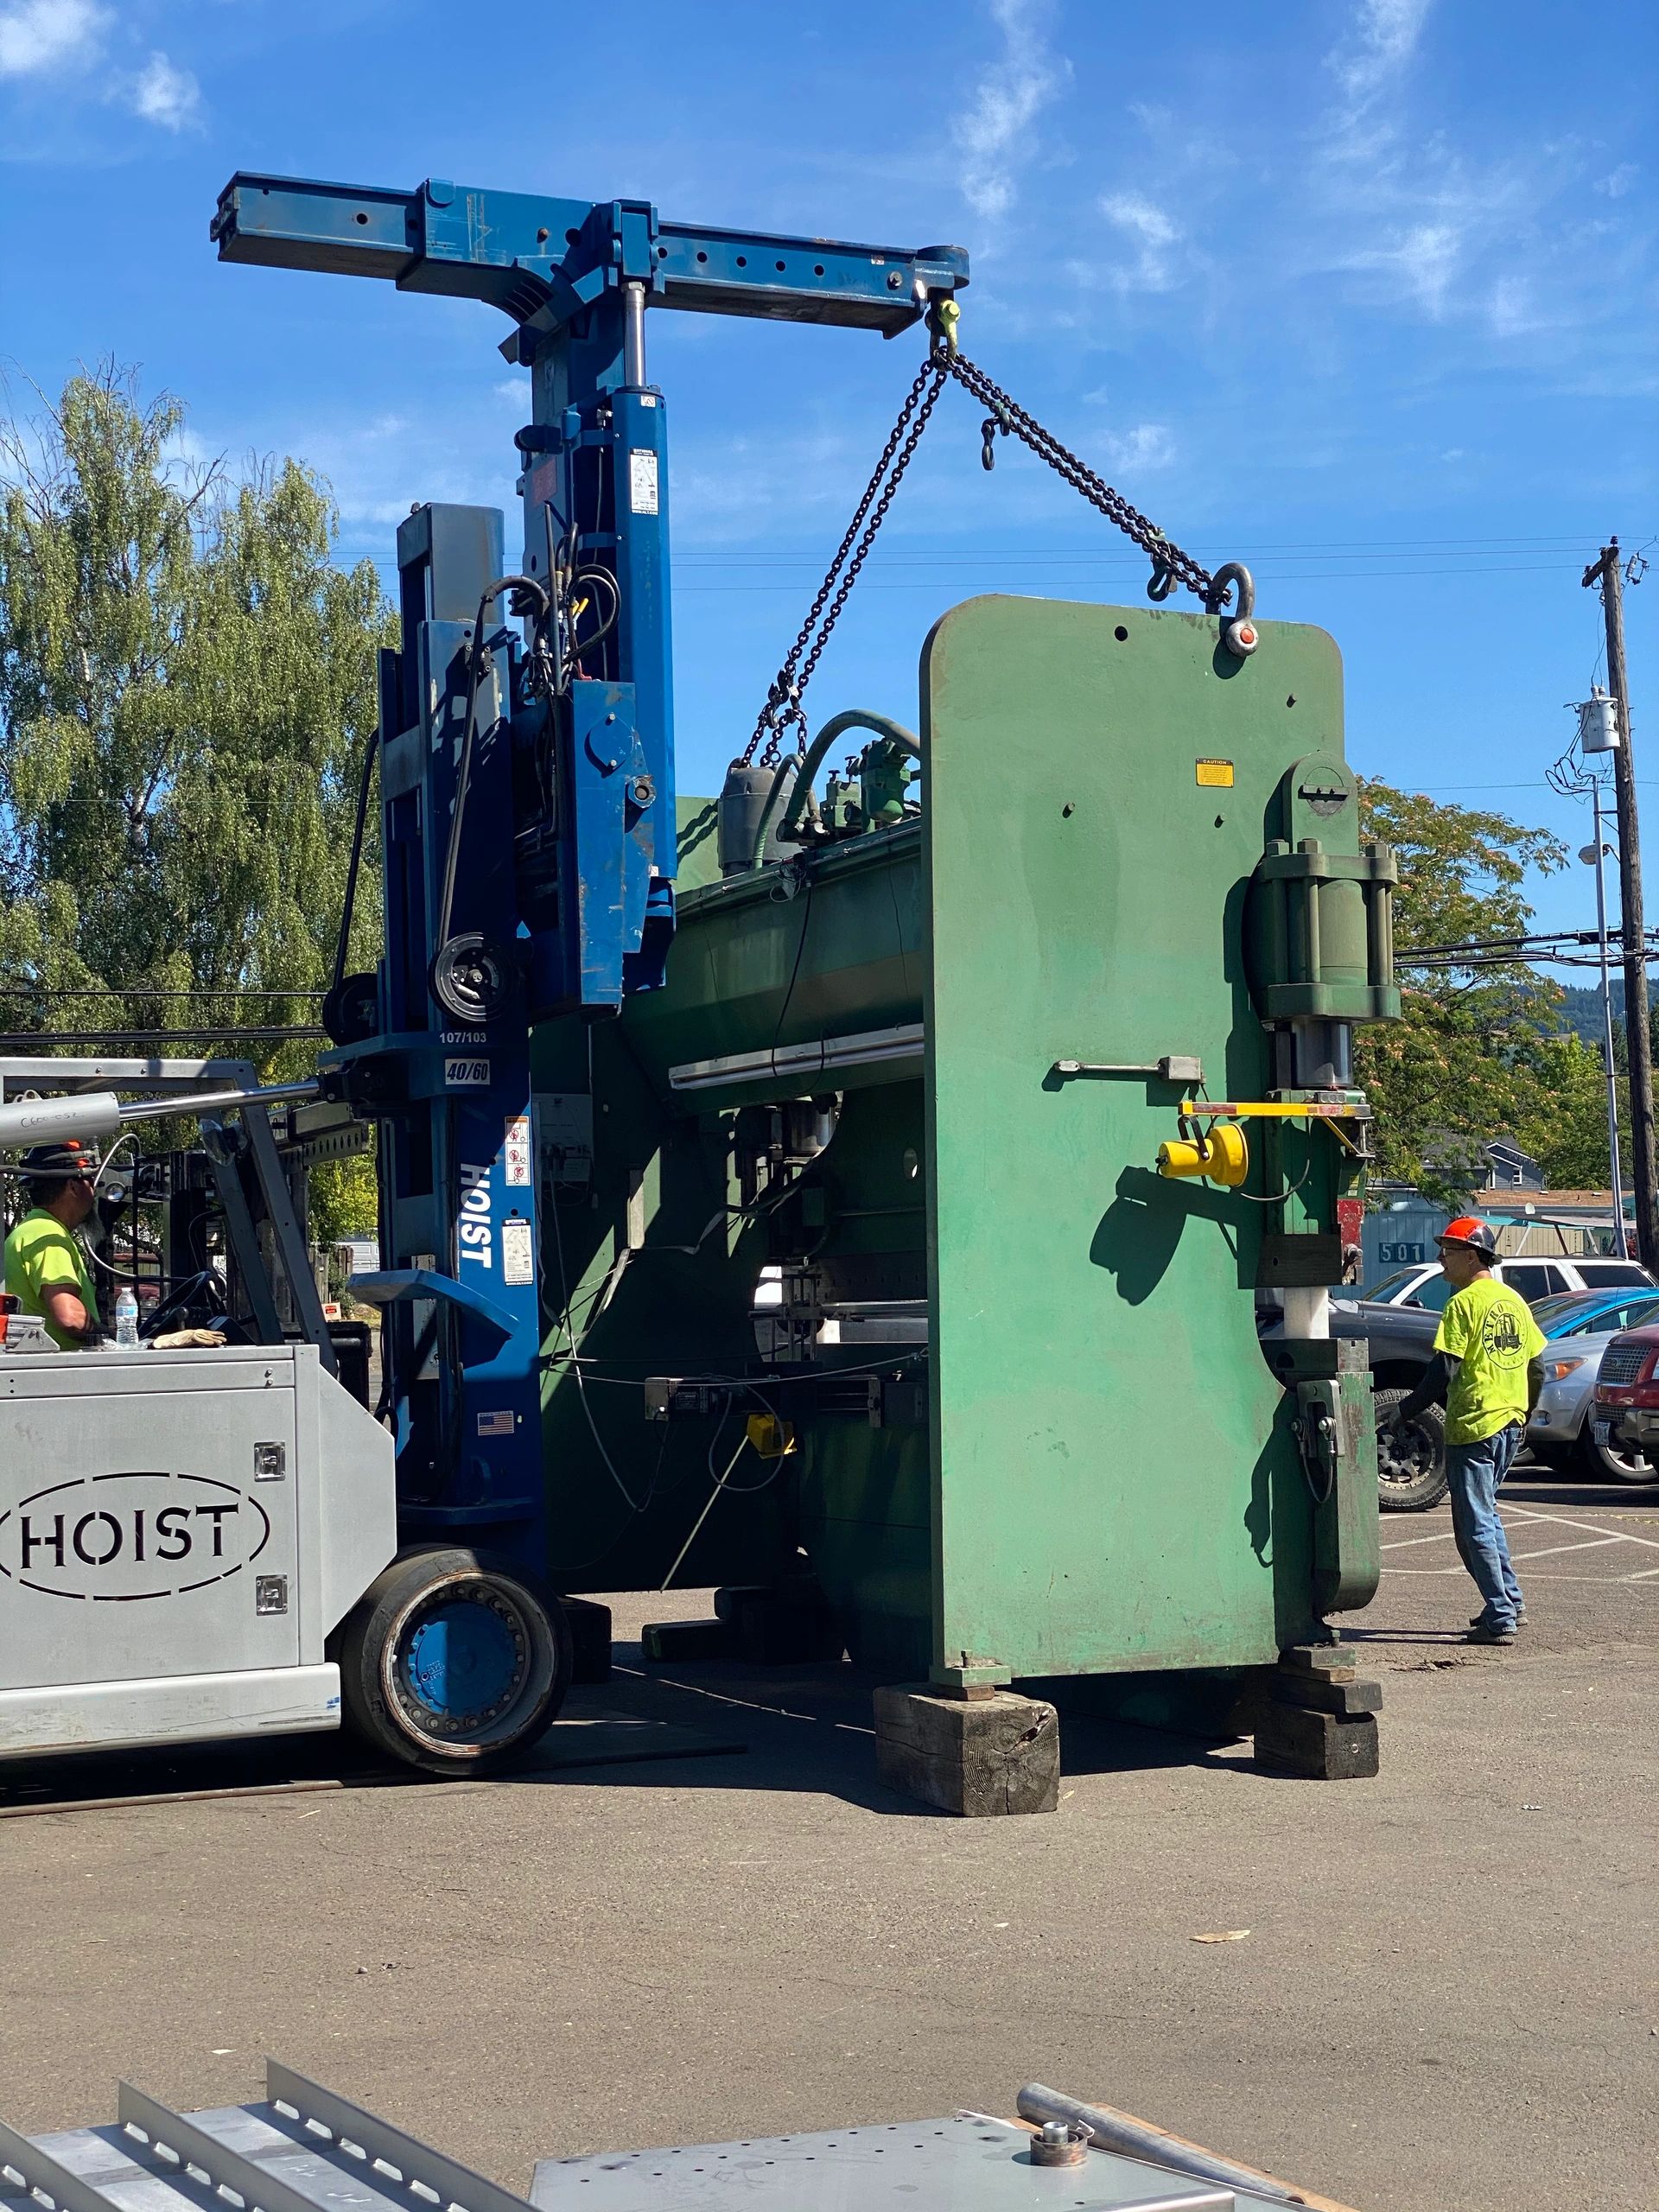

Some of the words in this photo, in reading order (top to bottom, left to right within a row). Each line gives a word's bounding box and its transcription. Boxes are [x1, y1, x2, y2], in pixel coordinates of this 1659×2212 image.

[439, 1032, 486, 1044] 107/103
[446, 1062, 488, 1080] 40/60
[460, 1163, 492, 1268] HOIST
[1382, 1243, 1421, 1262] 501
[1484, 1303, 1503, 1355] METRO
[20, 1503, 239, 1569] HOIST
